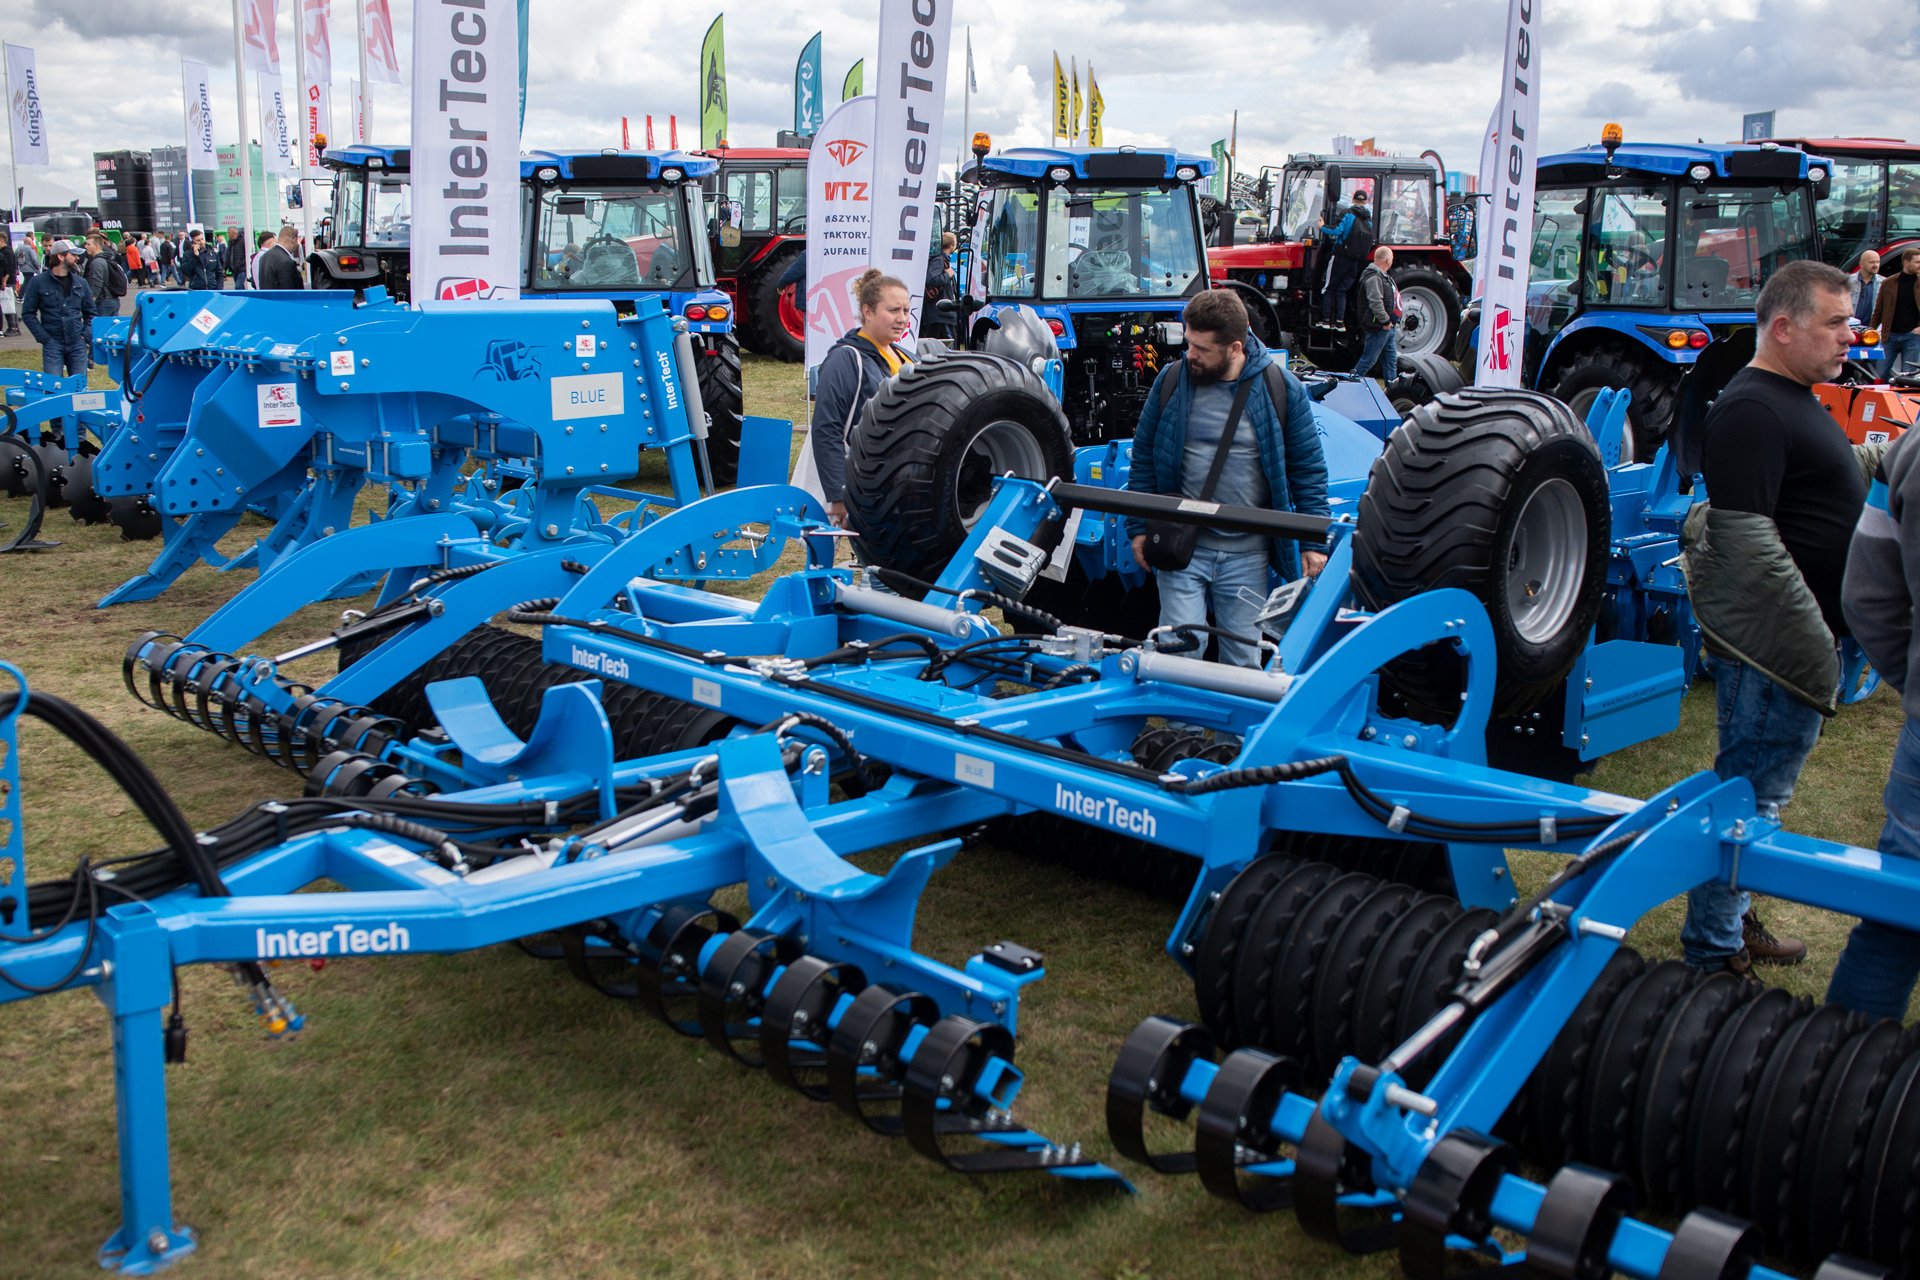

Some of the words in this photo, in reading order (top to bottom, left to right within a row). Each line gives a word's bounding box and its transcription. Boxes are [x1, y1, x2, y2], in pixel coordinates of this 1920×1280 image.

[26, 68, 43, 147] Kingspan
[199, 82, 213, 153] Kingspan
[273, 91, 290, 159] Kingspan
[439, 0, 489, 255] InterTec
[102, 220, 122, 229] WODA
[570, 389, 606, 405] BLUE
[572, 645, 629, 679] InterTech
[964, 763, 985, 778] BLUE
[1055, 782, 1157, 838] InterTech
[256, 921, 410, 958] InterTech
